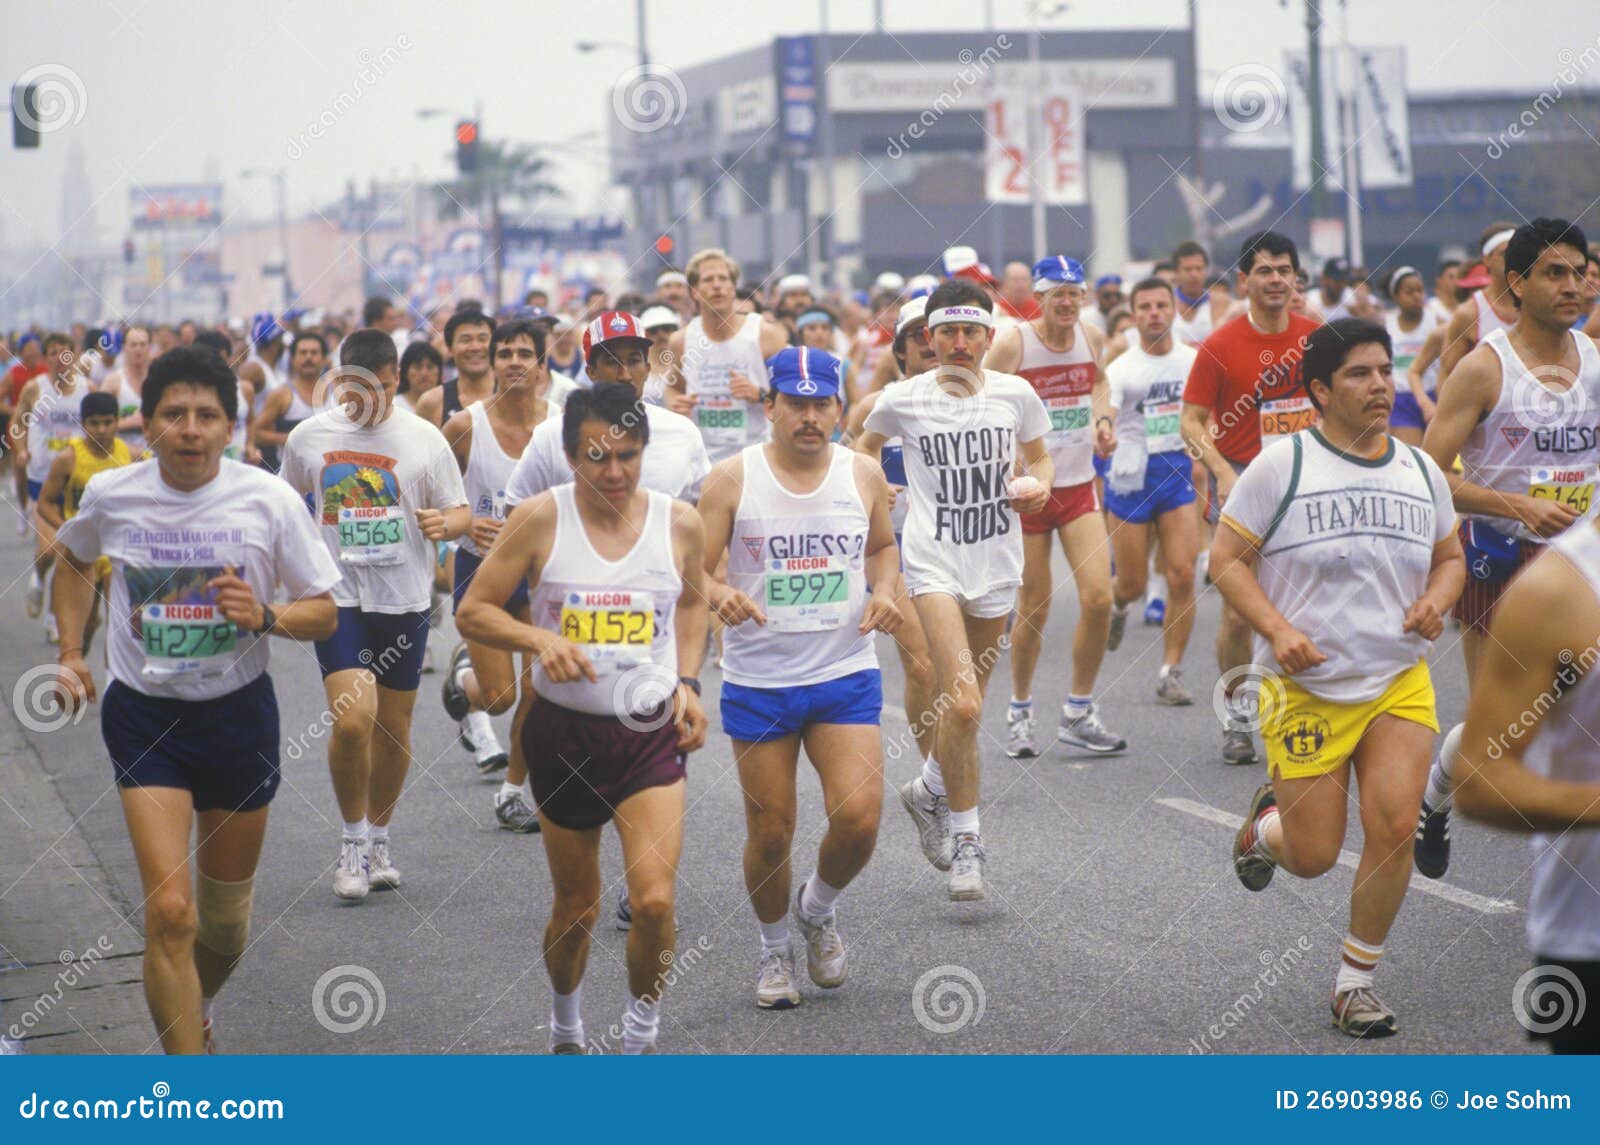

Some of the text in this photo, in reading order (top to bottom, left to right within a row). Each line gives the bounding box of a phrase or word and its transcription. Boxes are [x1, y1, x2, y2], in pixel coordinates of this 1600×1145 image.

[1044, 97, 1074, 192] OFF
[1147, 380, 1184, 401] NIKE
[919, 427, 1012, 467] BOYCOTT
[935, 461, 1010, 505] JUNK
[1553, 471, 1585, 483] RICOH
[354, 507, 388, 518] RICOH
[934, 499, 1010, 545] FOODS
[1305, 496, 1432, 538] HAMILTON
[341, 519, 401, 546] H563
[786, 558, 828, 570] RICOH
[585, 593, 631, 606] RICOH
[770, 572, 843, 605] E997
[165, 605, 213, 620] RICOH
[564, 611, 646, 644] A152
[146, 624, 231, 658] H279
